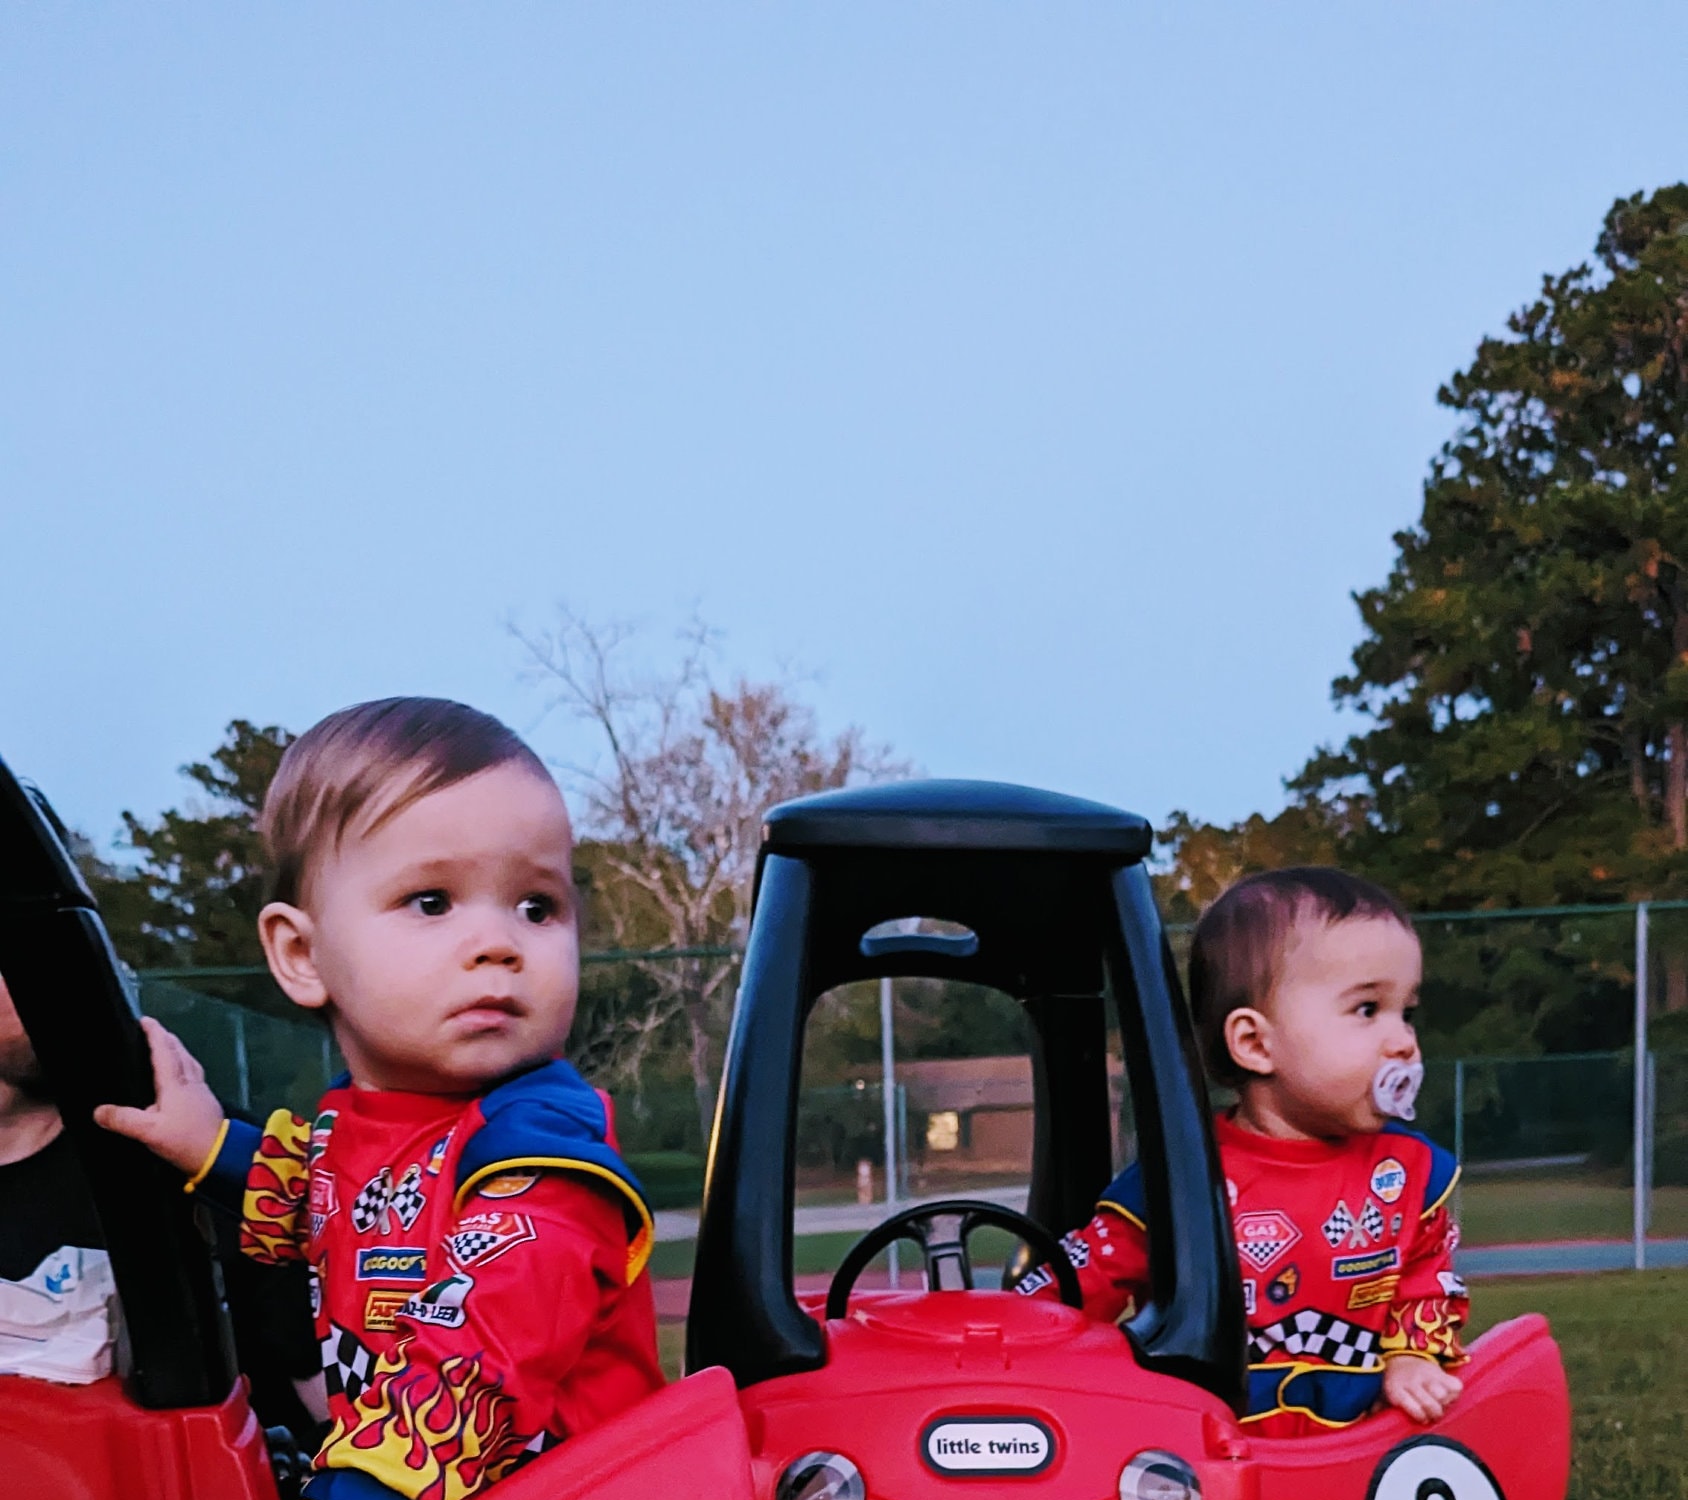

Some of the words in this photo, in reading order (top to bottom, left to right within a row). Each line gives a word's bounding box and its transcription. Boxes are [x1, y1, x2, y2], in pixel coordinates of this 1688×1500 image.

[1243, 1224, 1279, 1237] GAS
[936, 1438, 981, 1455] little
[988, 1438, 1040, 1454] twins
